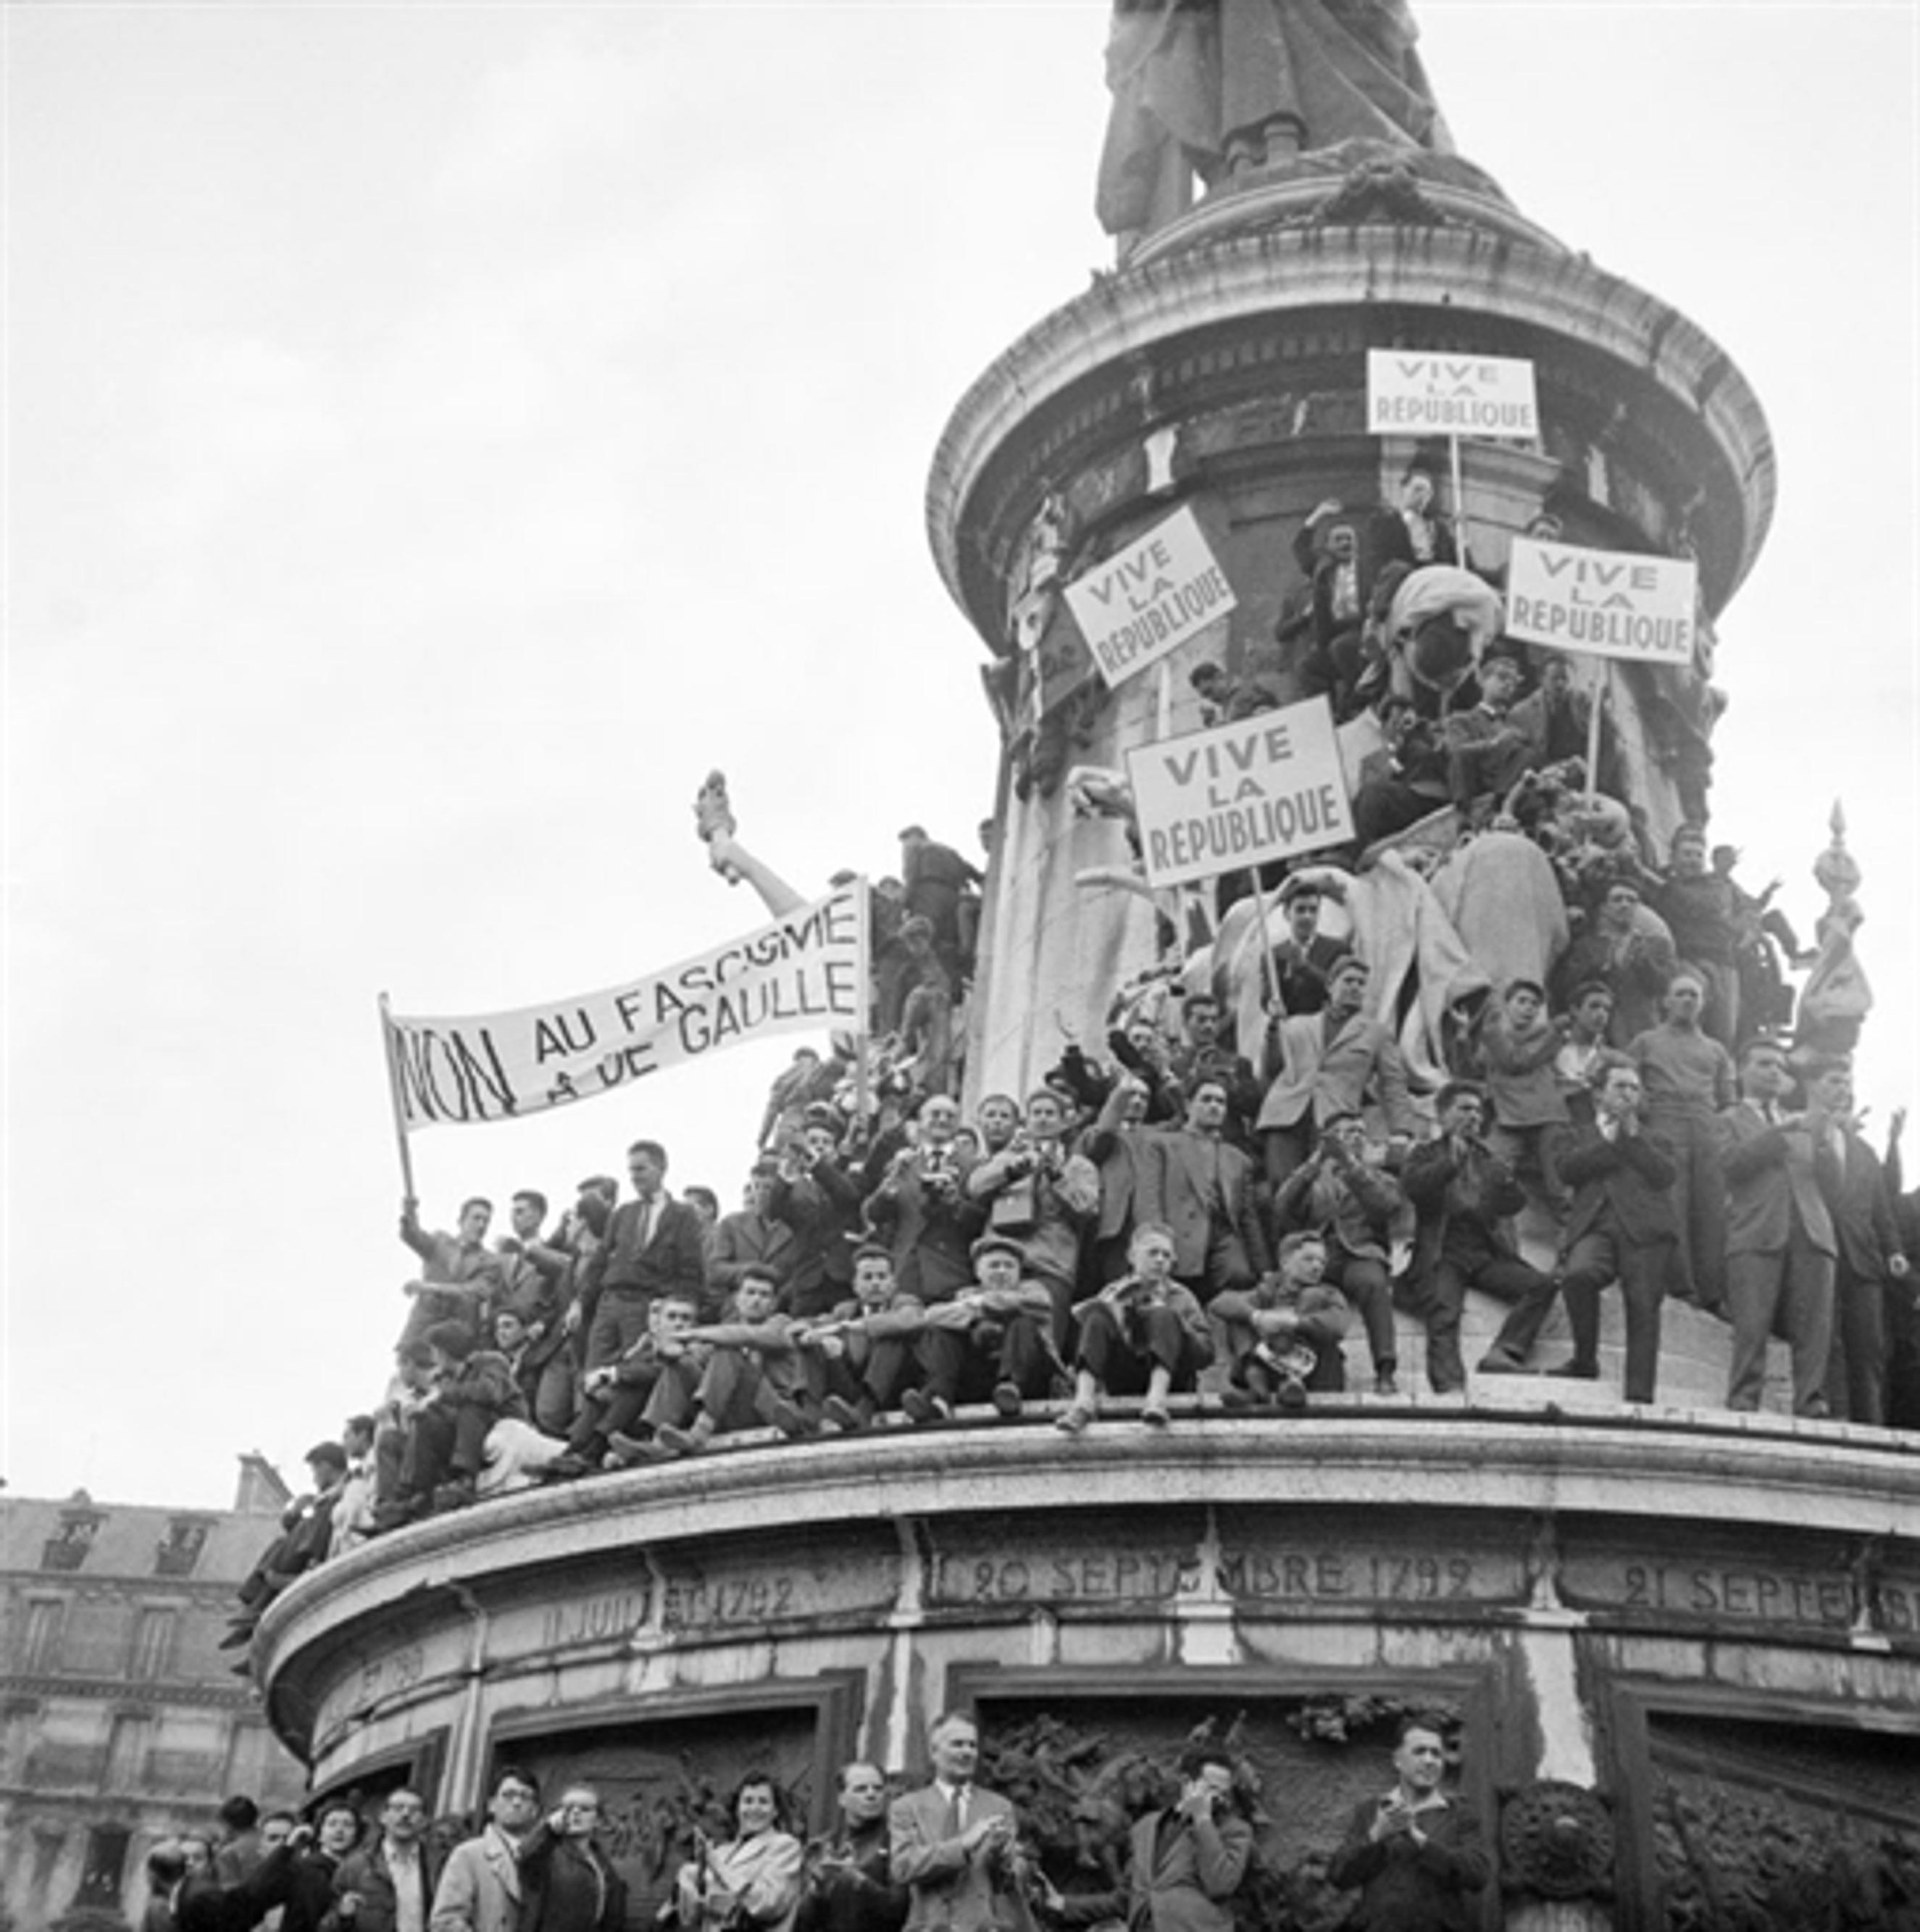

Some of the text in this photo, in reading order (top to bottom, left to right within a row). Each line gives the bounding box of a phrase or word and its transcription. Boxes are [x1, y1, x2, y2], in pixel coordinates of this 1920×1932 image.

[1395, 359, 1498, 385] VIVE
[1426, 383, 1478, 398] LA
[1376, 396, 1533, 428] REPUBLIQUE
[1088, 539, 1172, 606] VIVE
[1539, 550, 1658, 591] VIVE
[1127, 577, 1174, 612] LA
[1569, 586, 1635, 610] LA
[1096, 565, 1227, 673] REPUBLIQUE
[1511, 594, 1689, 652] REPUBLIQUE
[1162, 725, 1294, 786] VIVE
[1207, 776, 1266, 809] LA
[1148, 783, 1341, 872] REPUBLIQUE
[678, 961, 857, 1054] GAULLE
[396, 1025, 518, 1123] NON
[535, 1007, 596, 1064] AU
[1624, 1565, 1666, 1607] 21
